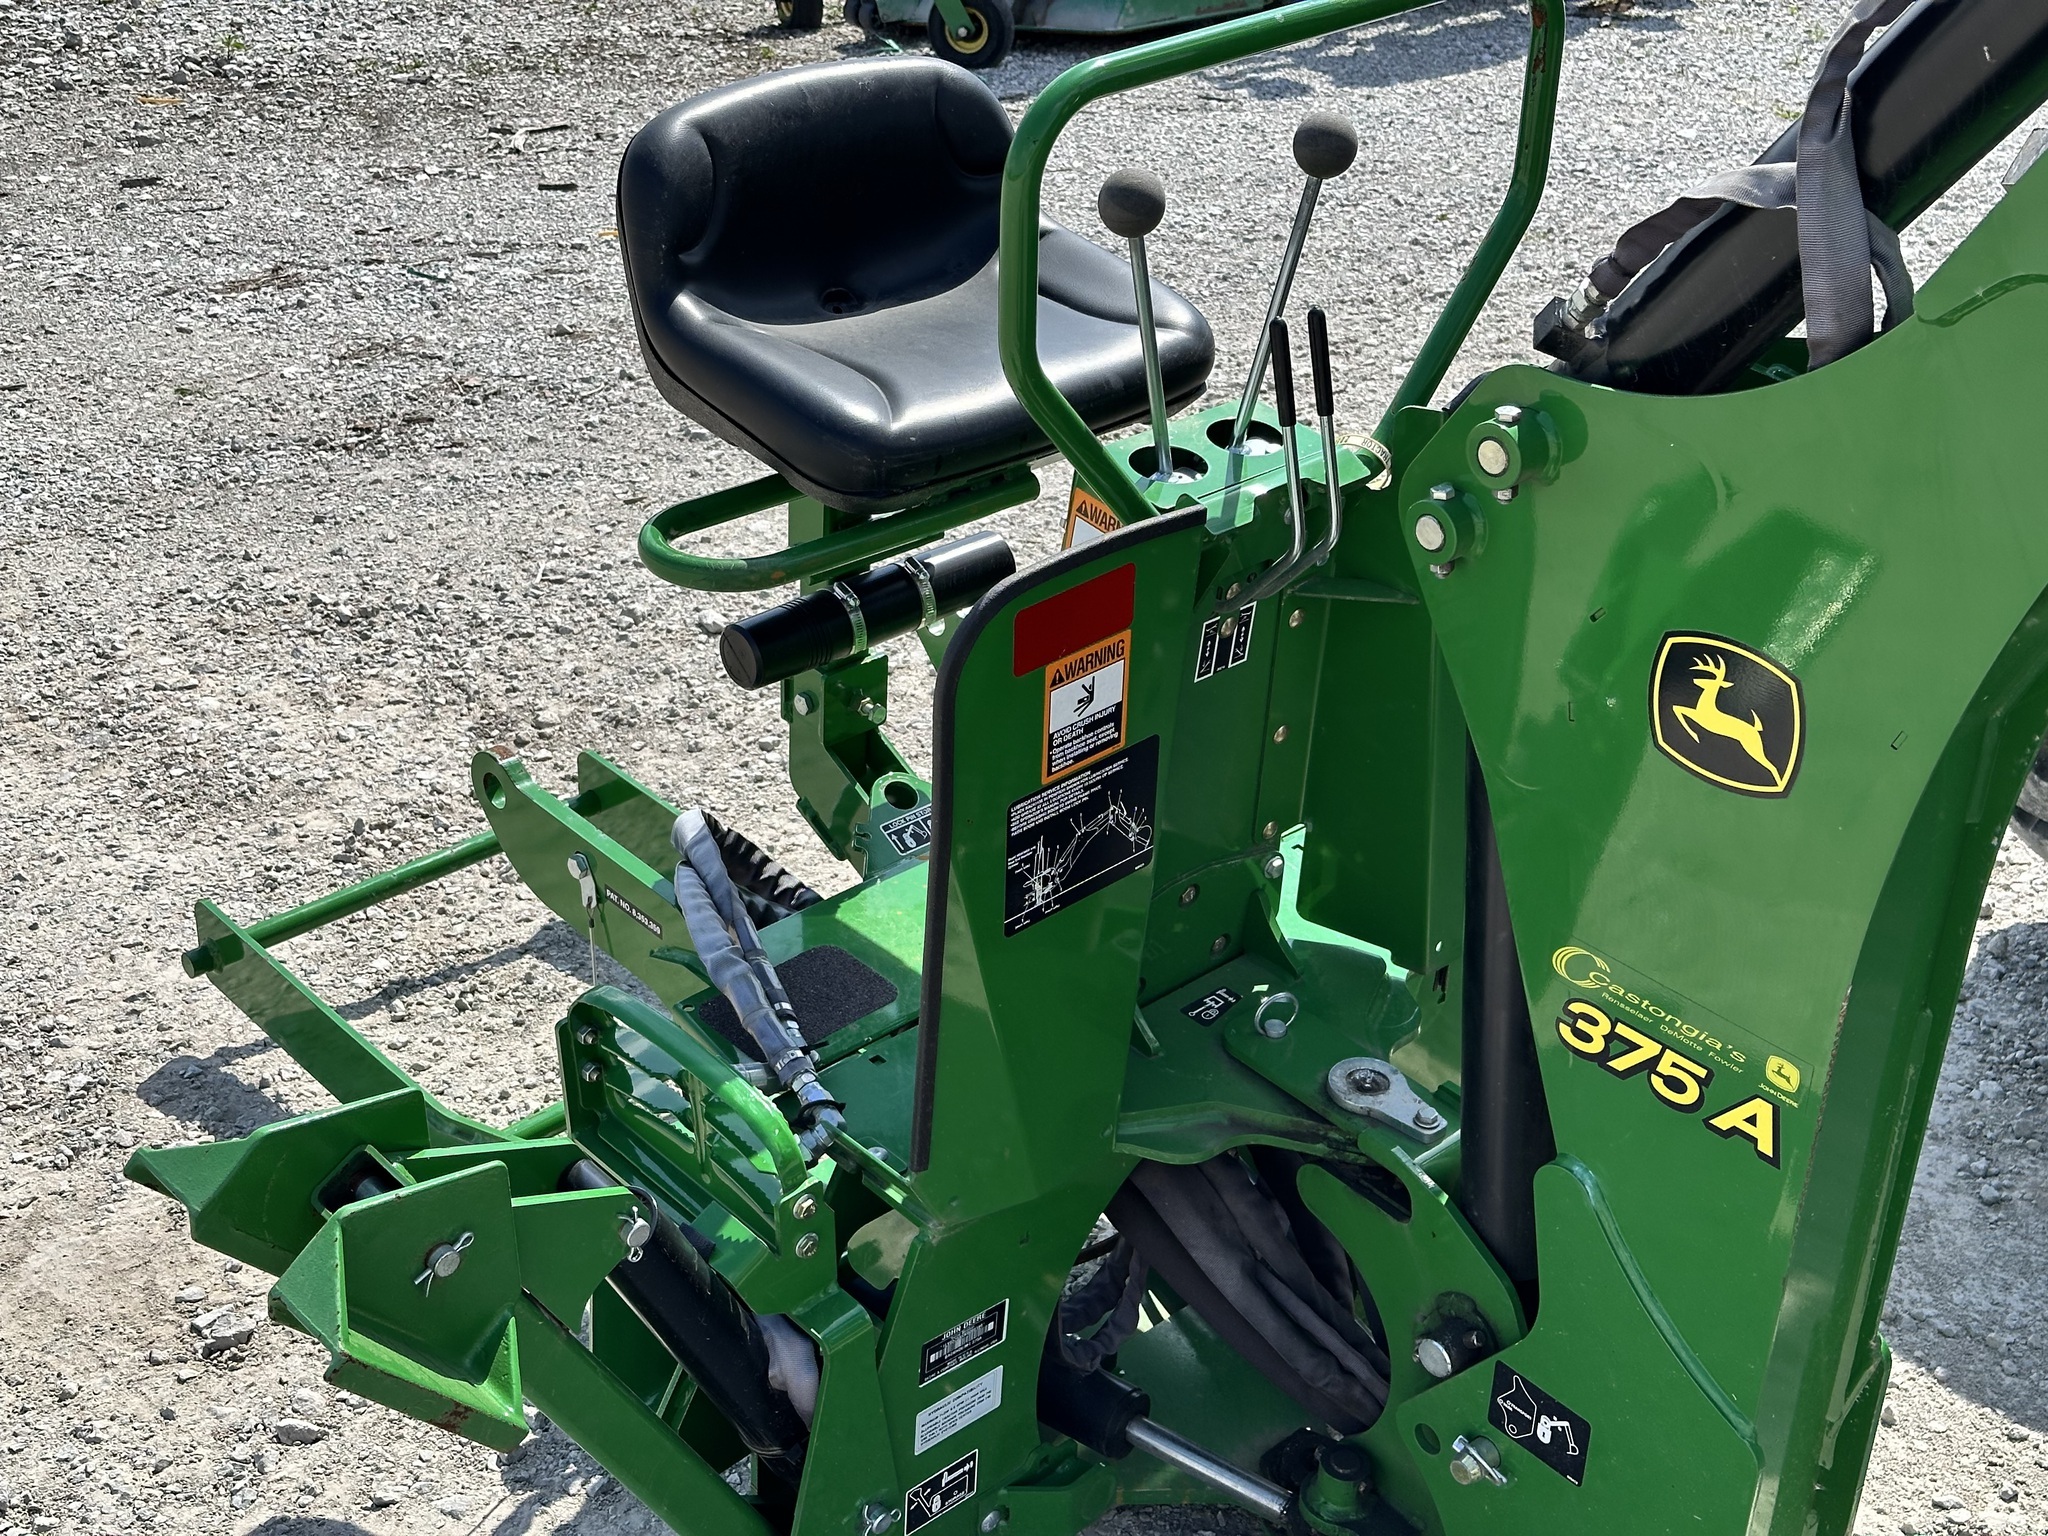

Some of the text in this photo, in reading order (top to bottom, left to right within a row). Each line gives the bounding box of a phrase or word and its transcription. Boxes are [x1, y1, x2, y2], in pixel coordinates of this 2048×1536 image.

[1361, 438, 1390, 464] TRACTOR
[1064, 639, 1125, 681] WARNING
[1053, 705, 1116, 739] AVOID CRUSH INJURY
[1053, 727, 1084, 746] OR DEATH
[889, 819, 907, 828] LOCK
[906, 814, 916, 823] PIN
[606, 889, 619, 904] PAT.
[620, 899, 631, 913] NO.
[1552, 946, 1746, 1063] Castongia's
[1601, 992, 1744, 1074] Rensselaer DeMotte Fowler
[1758, 1083, 1799, 1108] JOHN DEERE
[942, 1324, 961, 1341] JOHN
[963, 1312, 986, 1329] DEERE
